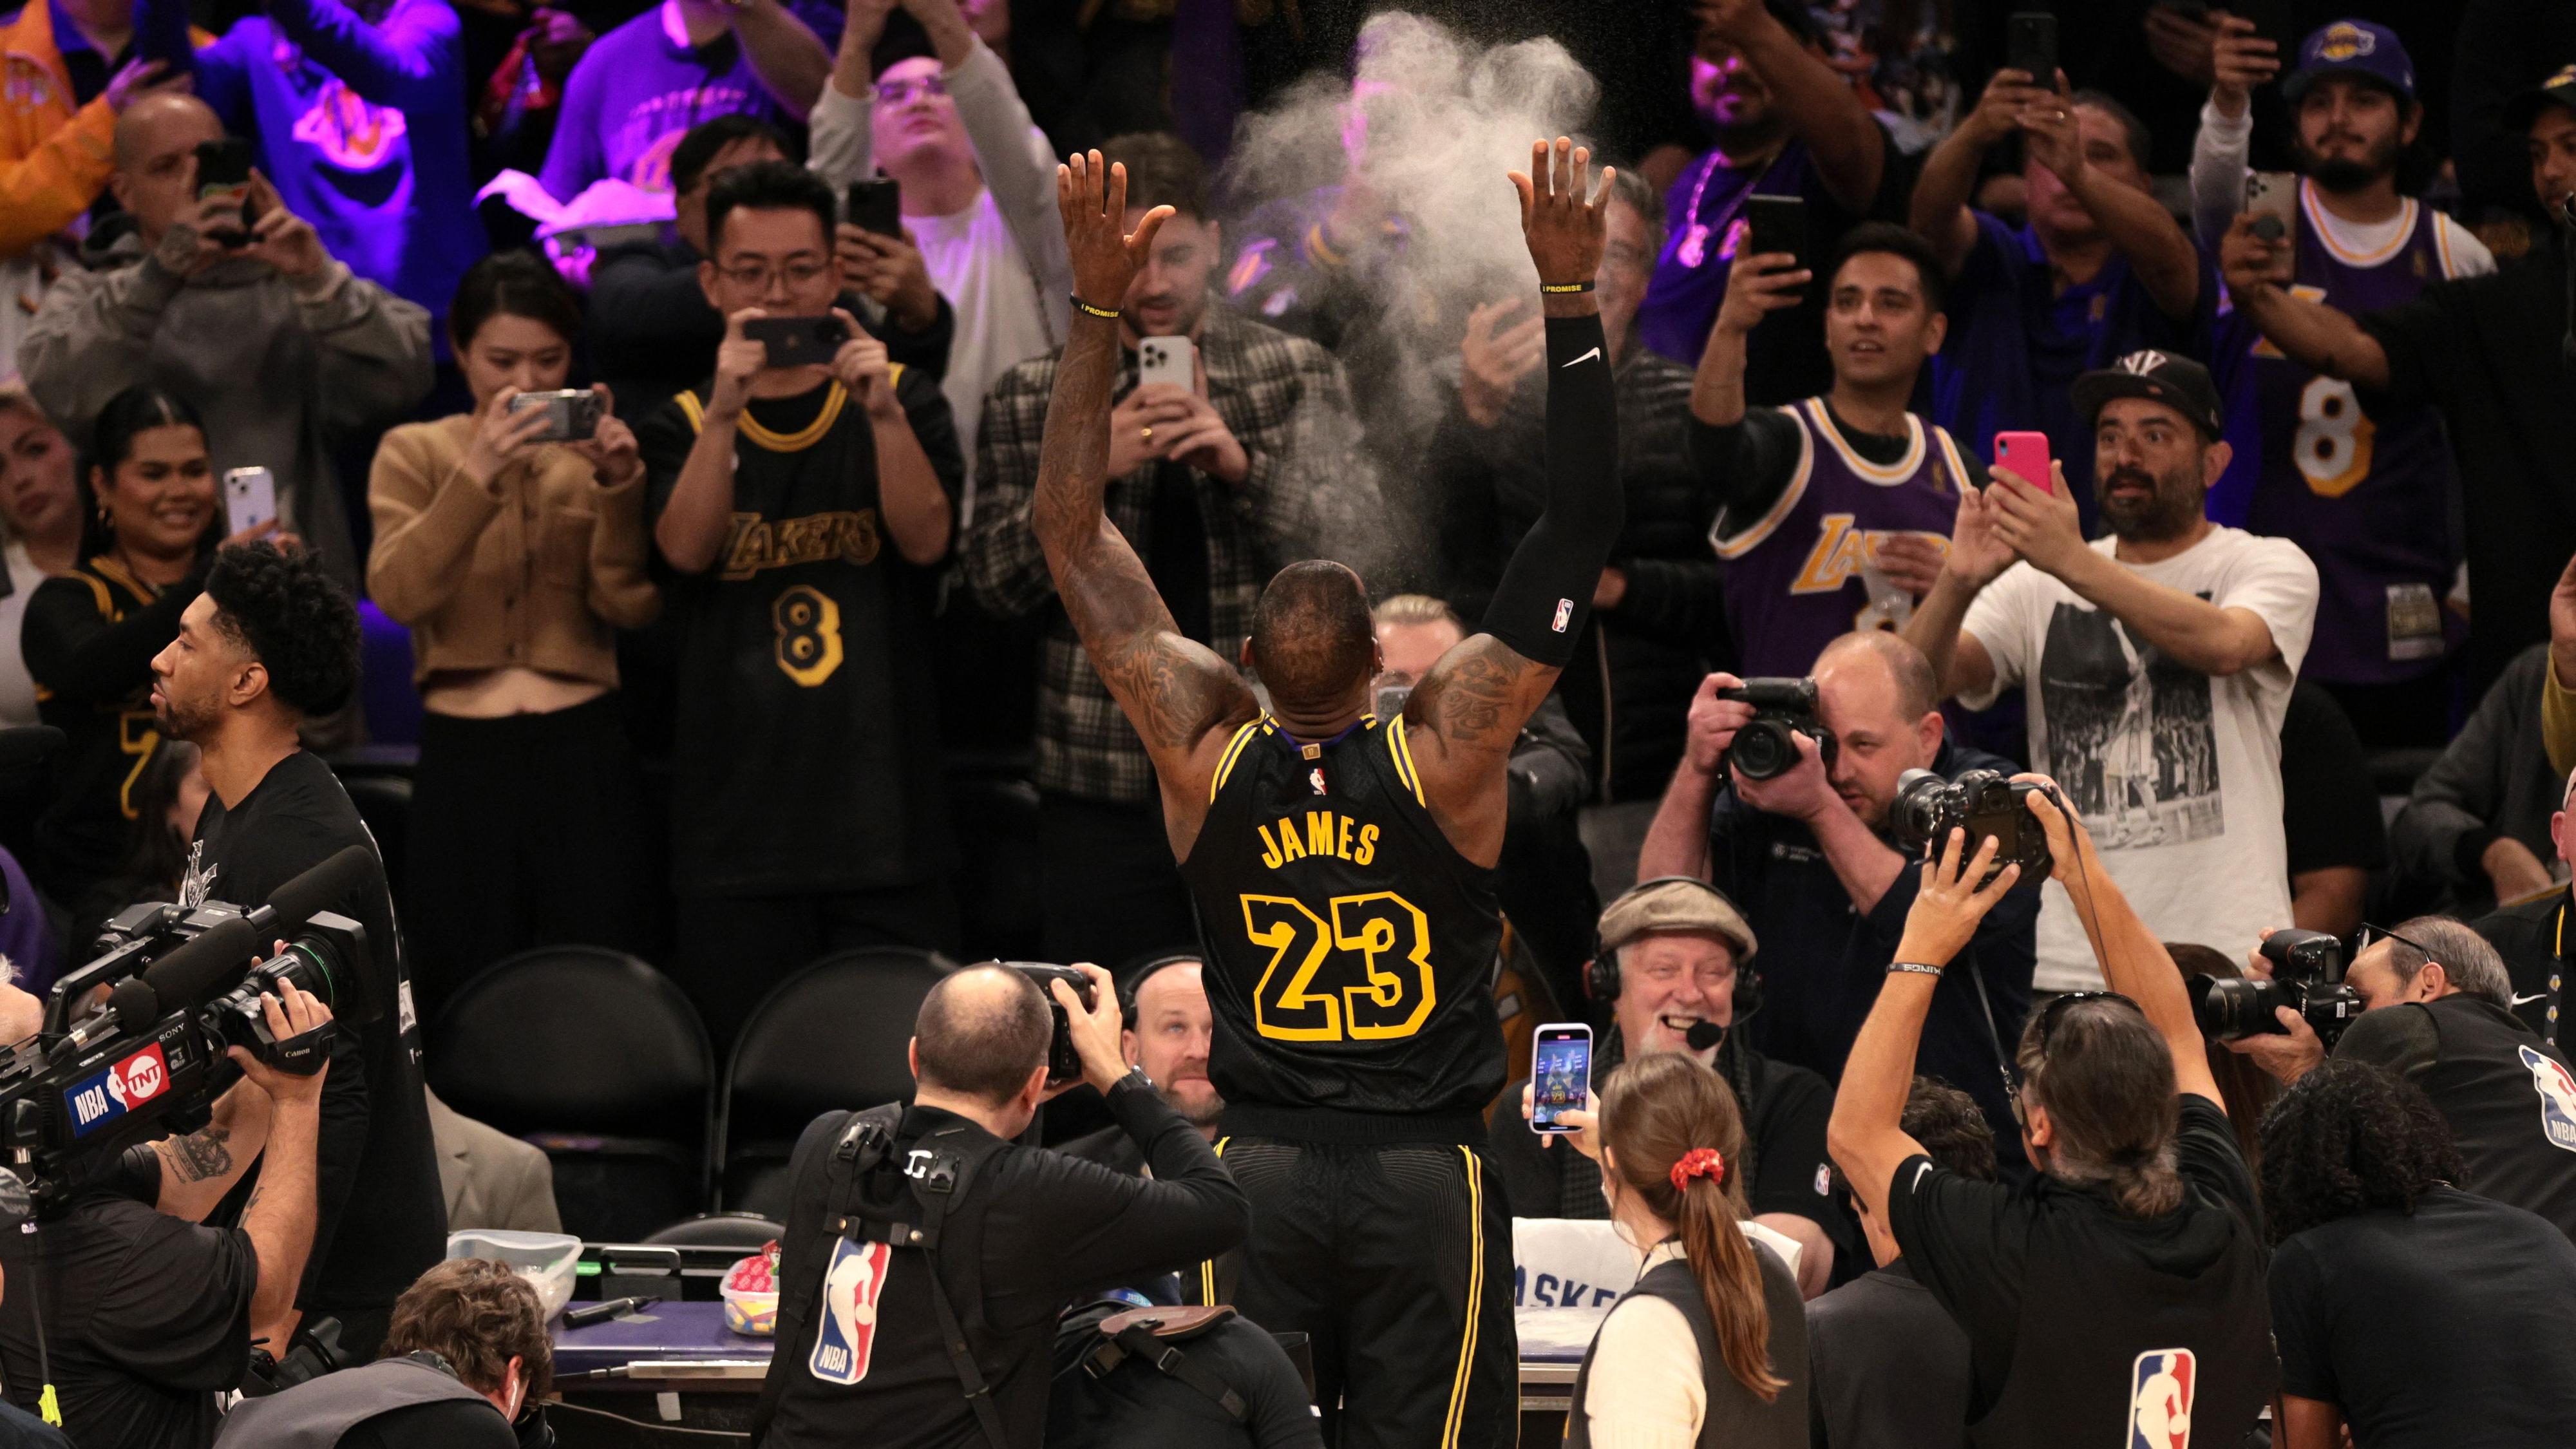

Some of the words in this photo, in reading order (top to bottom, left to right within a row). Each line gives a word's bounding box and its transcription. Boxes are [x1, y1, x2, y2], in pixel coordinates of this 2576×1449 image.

[1085, 305, 1119, 317] PROMISE
[2293, 374, 2376, 498] 8
[772, 584, 844, 687] 8
[1257, 811, 1380, 869] JAMES
[1239, 891, 1437, 1042] 23
[1903, 963, 1941, 974] KINGS
[159, 1023, 185, 1043] SONY
[285, 1048, 310, 1057] Canon
[74, 1084, 109, 1126] NBA
[128, 1063, 160, 1092] TNT
[2551, 1119, 2576, 1144] NBA
[819, 1344, 848, 1373] NBA
